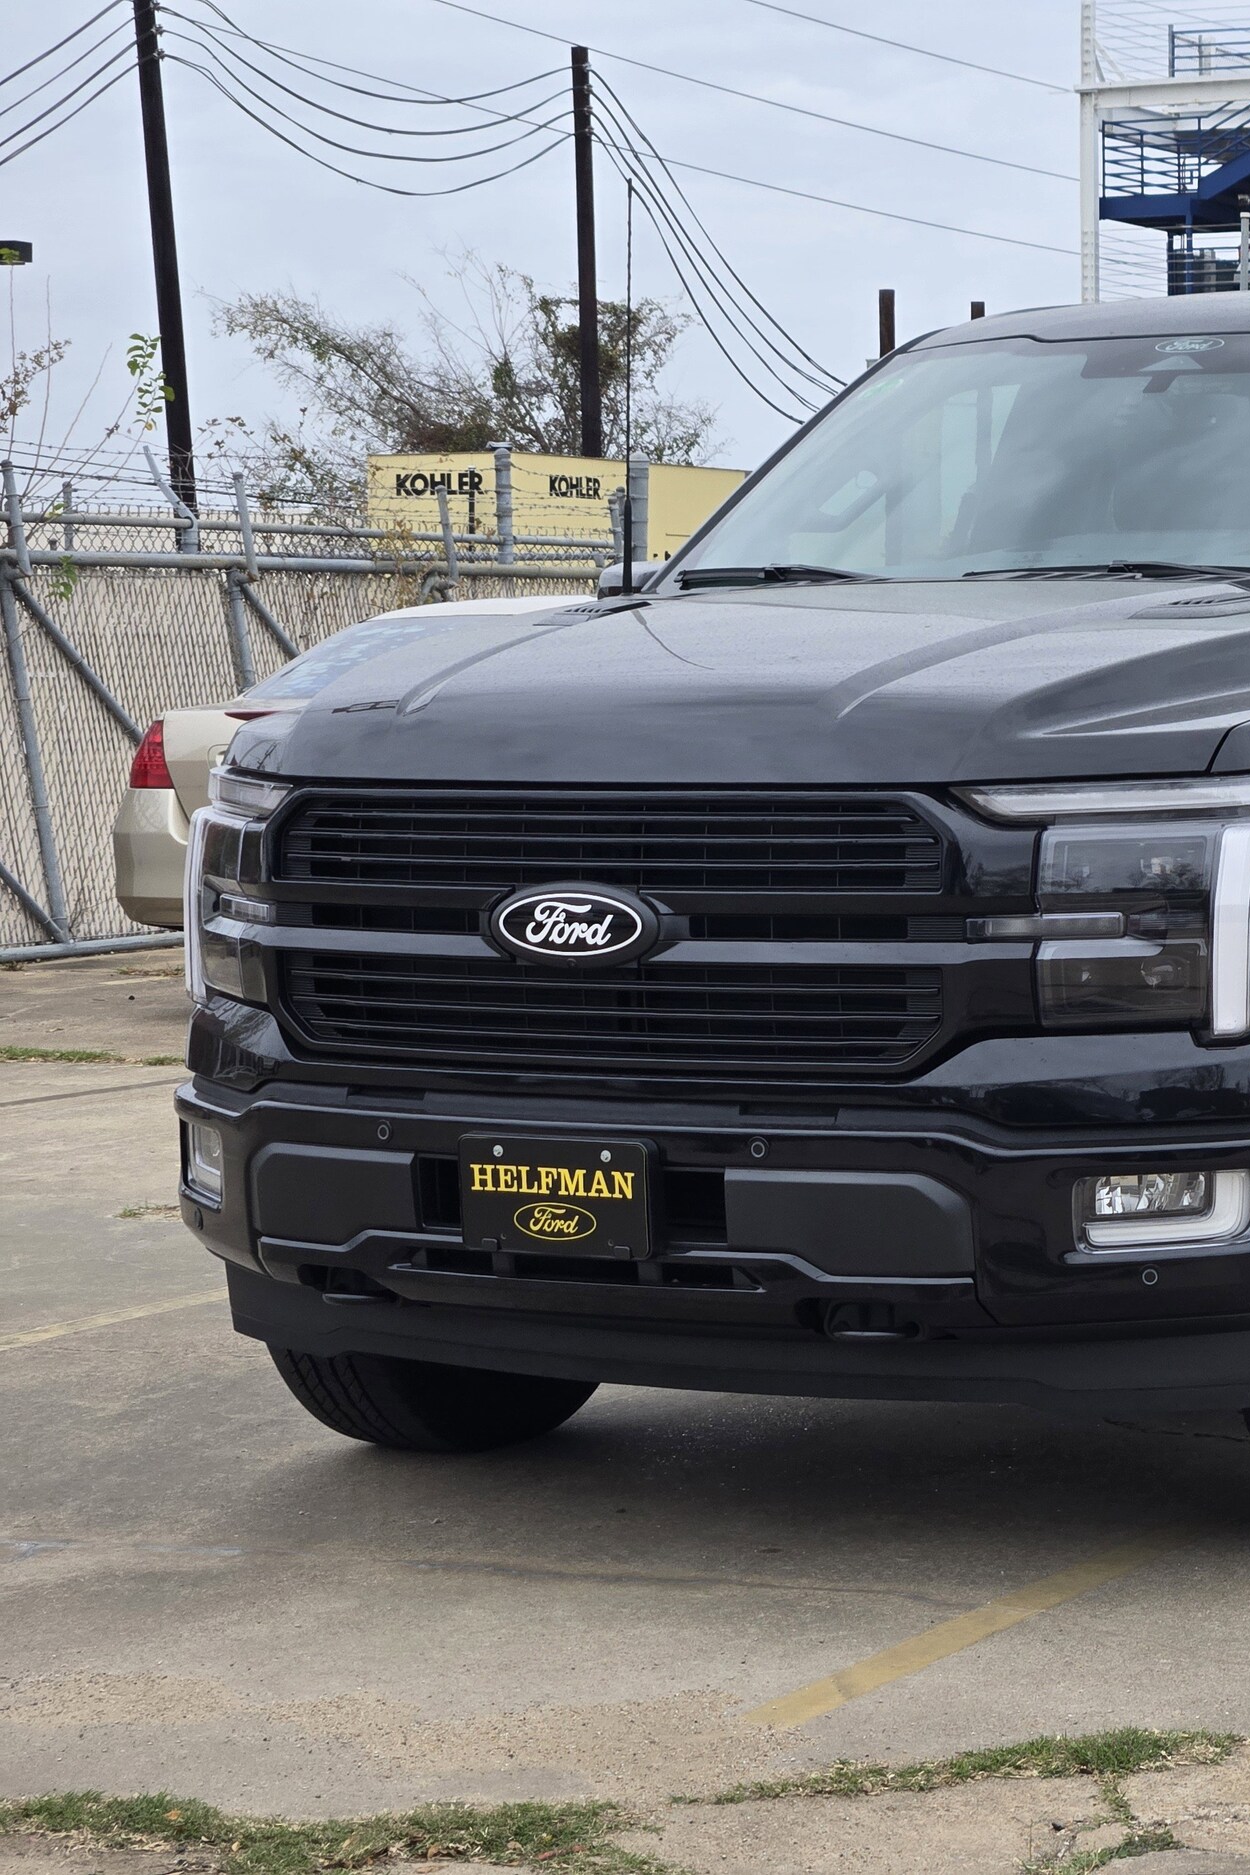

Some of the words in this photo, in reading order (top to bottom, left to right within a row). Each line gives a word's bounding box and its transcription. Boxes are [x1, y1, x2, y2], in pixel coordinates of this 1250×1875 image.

[395, 473, 485, 497] KOHLER
[549, 474, 602, 500] KOHLER
[525, 901, 614, 946] Ford
[469, 1163, 635, 1200] HELFMAN
[529, 1206, 580, 1234] Ford
